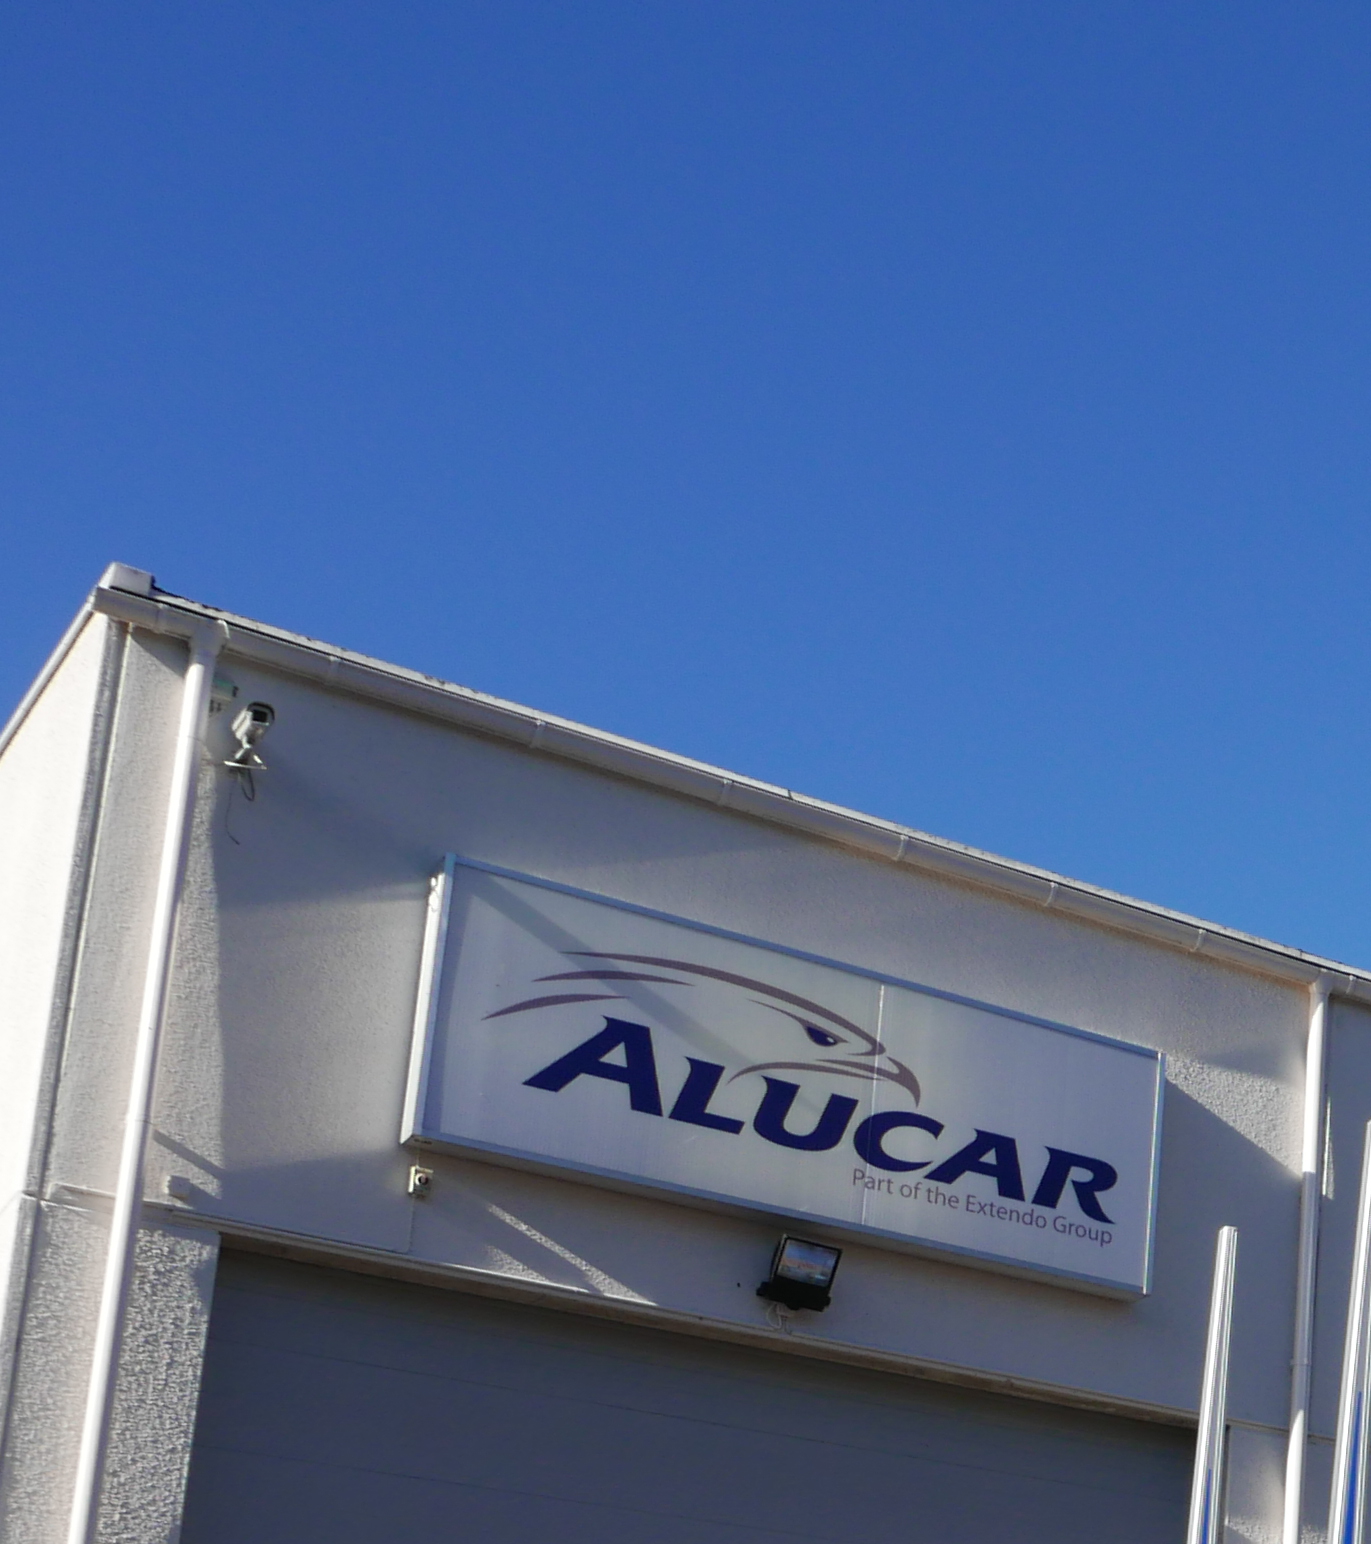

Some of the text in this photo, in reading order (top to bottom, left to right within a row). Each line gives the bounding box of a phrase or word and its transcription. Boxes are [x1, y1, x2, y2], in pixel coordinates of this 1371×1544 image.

[522, 1015, 1118, 1224] ALUCAR
[853, 1168, 1113, 1247] Part of the Extendo Group
